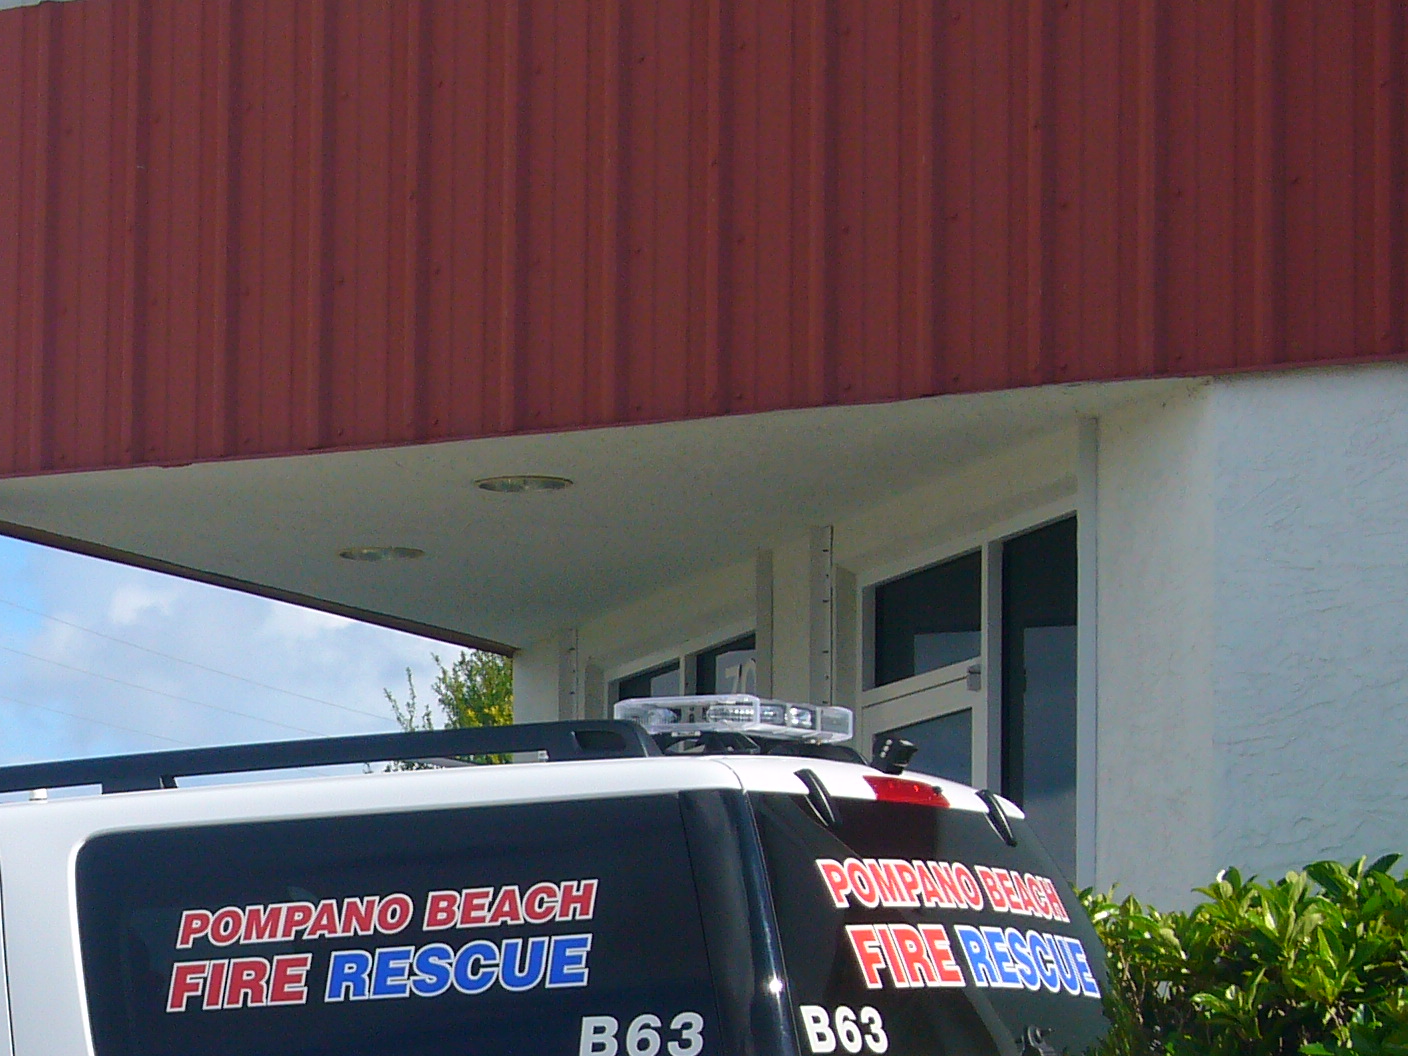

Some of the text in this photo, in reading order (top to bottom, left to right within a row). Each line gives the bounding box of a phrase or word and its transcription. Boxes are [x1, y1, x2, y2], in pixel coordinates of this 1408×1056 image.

[176, 879, 598, 949] POMPANO BEACH
[815, 857, 1070, 923] POMPANO BEACH
[166, 933, 592, 1012] FIRE RESCUE
[845, 923, 1101, 999] FIRE RESCUE
[799, 1004, 888, 1054] B63
